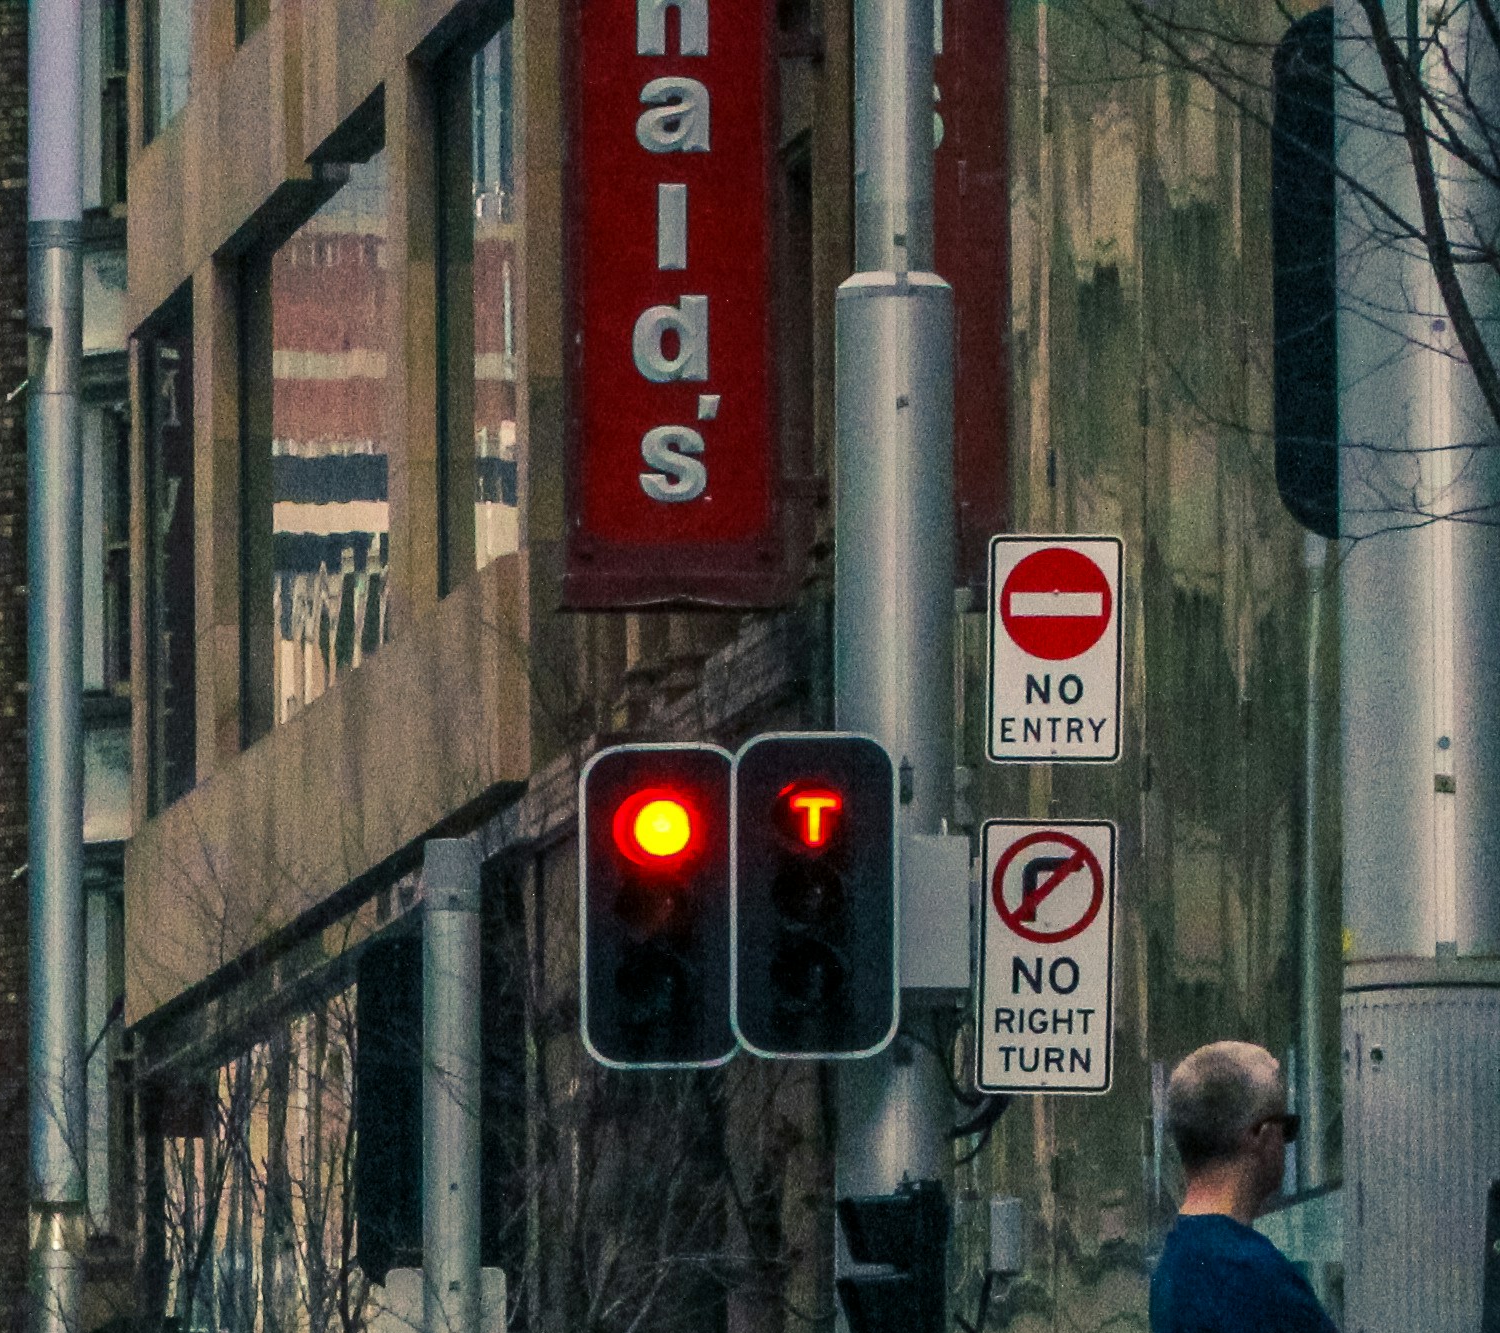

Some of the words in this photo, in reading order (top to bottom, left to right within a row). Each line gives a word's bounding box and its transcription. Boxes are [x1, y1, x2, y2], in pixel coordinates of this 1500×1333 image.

[1025, 673, 1084, 705] NO
[1000, 717, 1107, 743] ENTRY
[1011, 956, 1080, 995] NO
[994, 1008, 1095, 1035] RIGHT
[999, 1047, 1092, 1073] TURN
